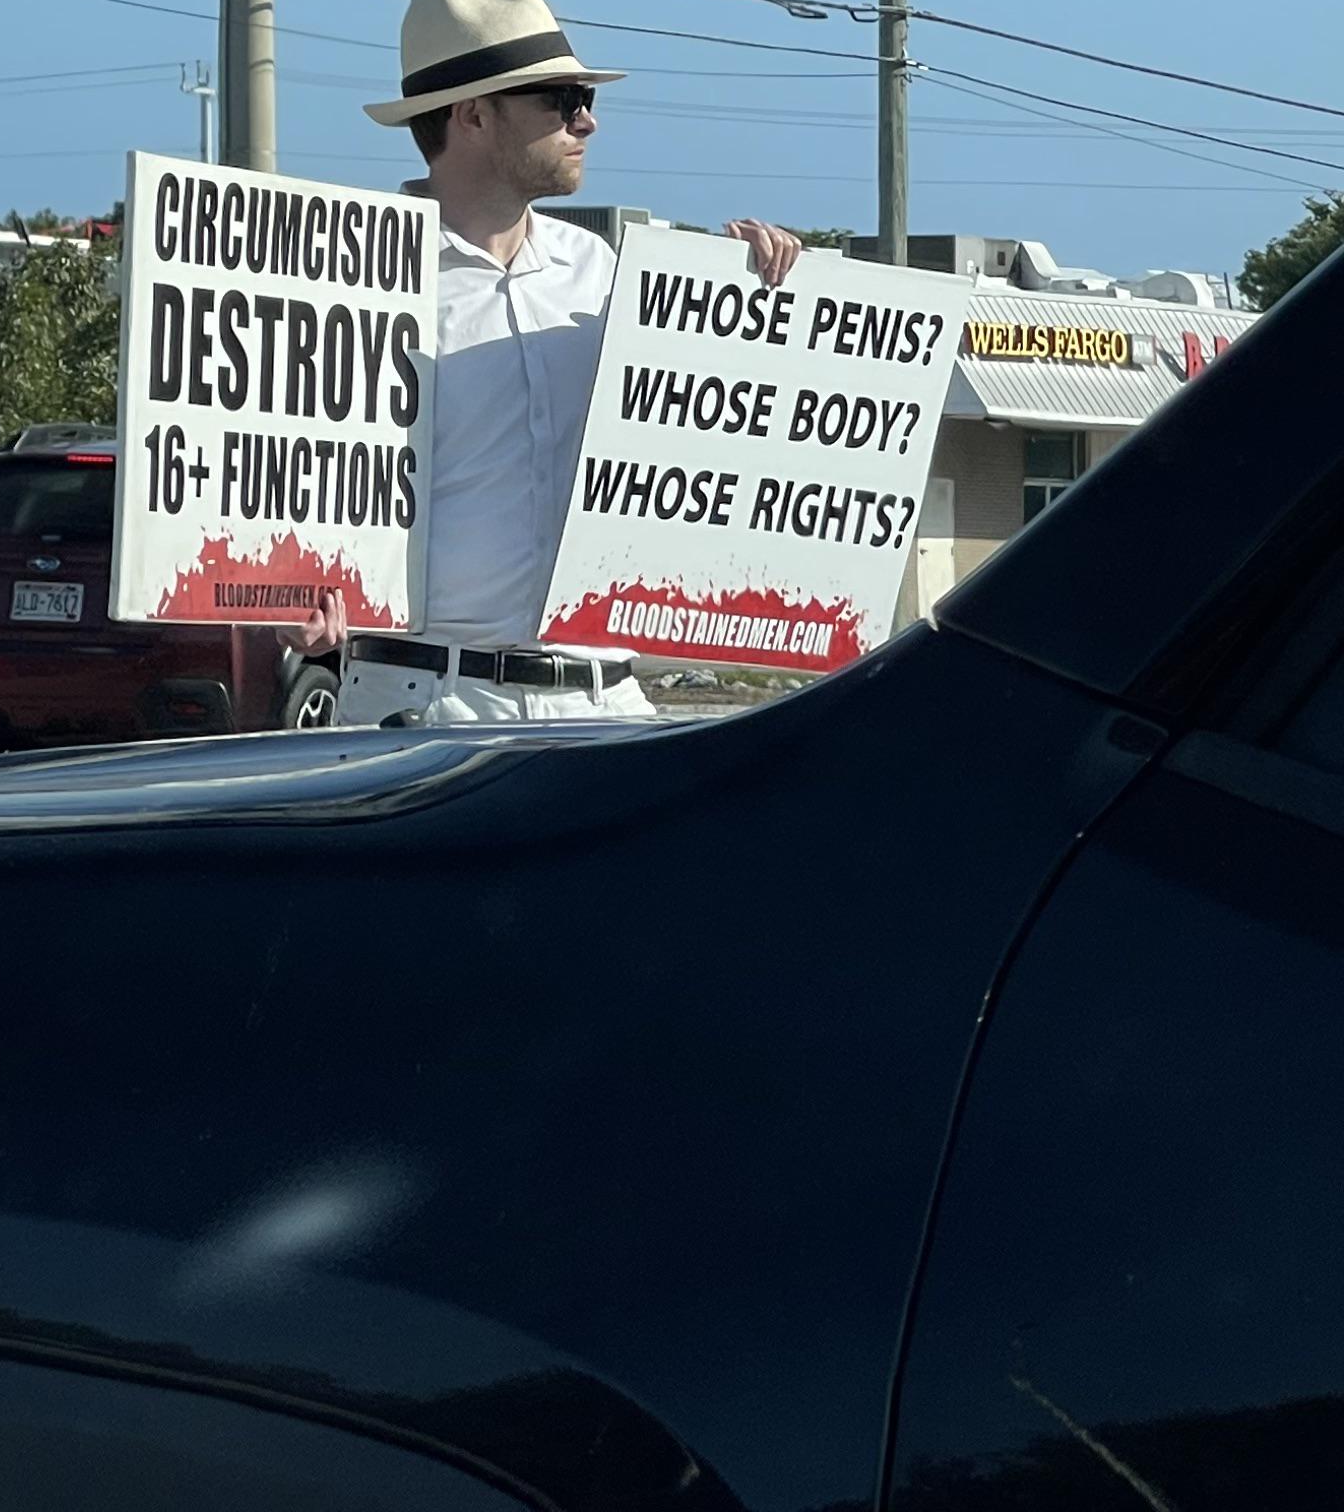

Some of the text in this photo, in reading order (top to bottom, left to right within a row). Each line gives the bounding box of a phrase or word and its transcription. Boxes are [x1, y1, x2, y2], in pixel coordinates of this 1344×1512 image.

[154, 172, 424, 294] CIRCUMCISION
[149, 282, 420, 428] DESTROYS
[639, 270, 944, 367] WHOSE PENIS?
[968, 321, 1049, 357] WELLS
[1053, 326, 1128, 364] FARGO
[621, 365, 921, 456] WHOSE BODY?
[144, 424, 417, 530] 16+ FUNCTIONS
[582, 457, 915, 550] WHOSE RIGHTS?
[606, 598, 834, 657] BLOODSTAINEDMEN.COM
